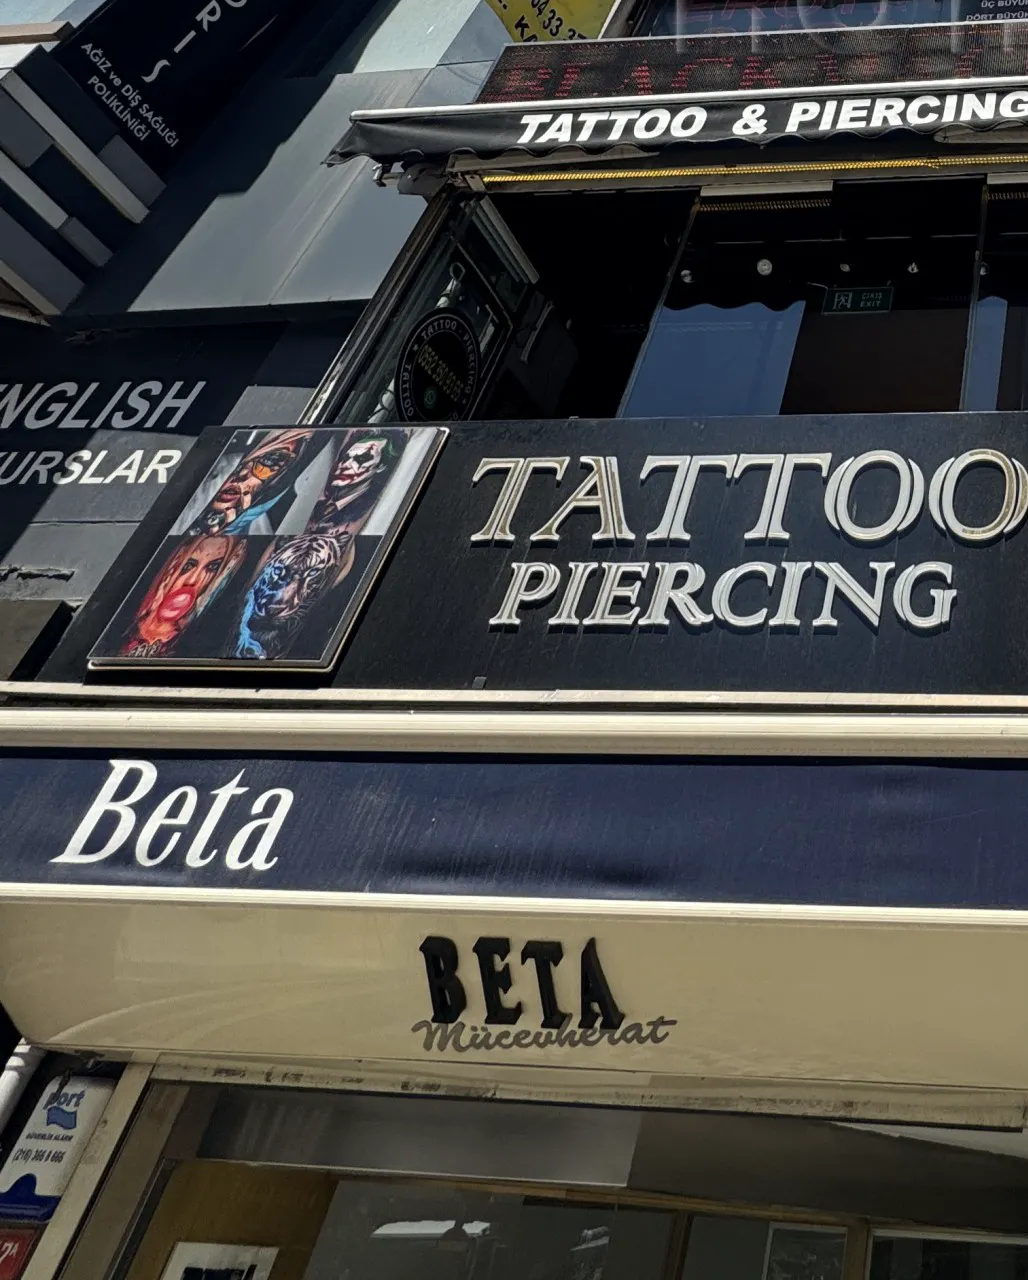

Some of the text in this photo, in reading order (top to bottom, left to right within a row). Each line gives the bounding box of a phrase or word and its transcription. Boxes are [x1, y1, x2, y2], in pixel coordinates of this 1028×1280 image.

[542, 8, 563, 37] 33
[965, 12, 994, 22] DÖRT
[981, 0, 995, 8] ÜÇ
[81, 42, 180, 148] AĞIZ ve DİŞ SAĞLIĞI
[87, 75, 151, 142] POLİKLİNİĞİ
[516, 105, 708, 146] TATTOO
[731, 103, 769, 137] &
[421, 319, 457, 340] TATTOO
[402, 363, 414, 417] TATTOO
[489, 561, 958, 631] PIERCING
[49, 759, 295, 871] Beta
[419, 936, 625, 1030] BETA
[411, 1015, 677, 1053] Mücevherat
[43, 1090, 85, 1110] port
